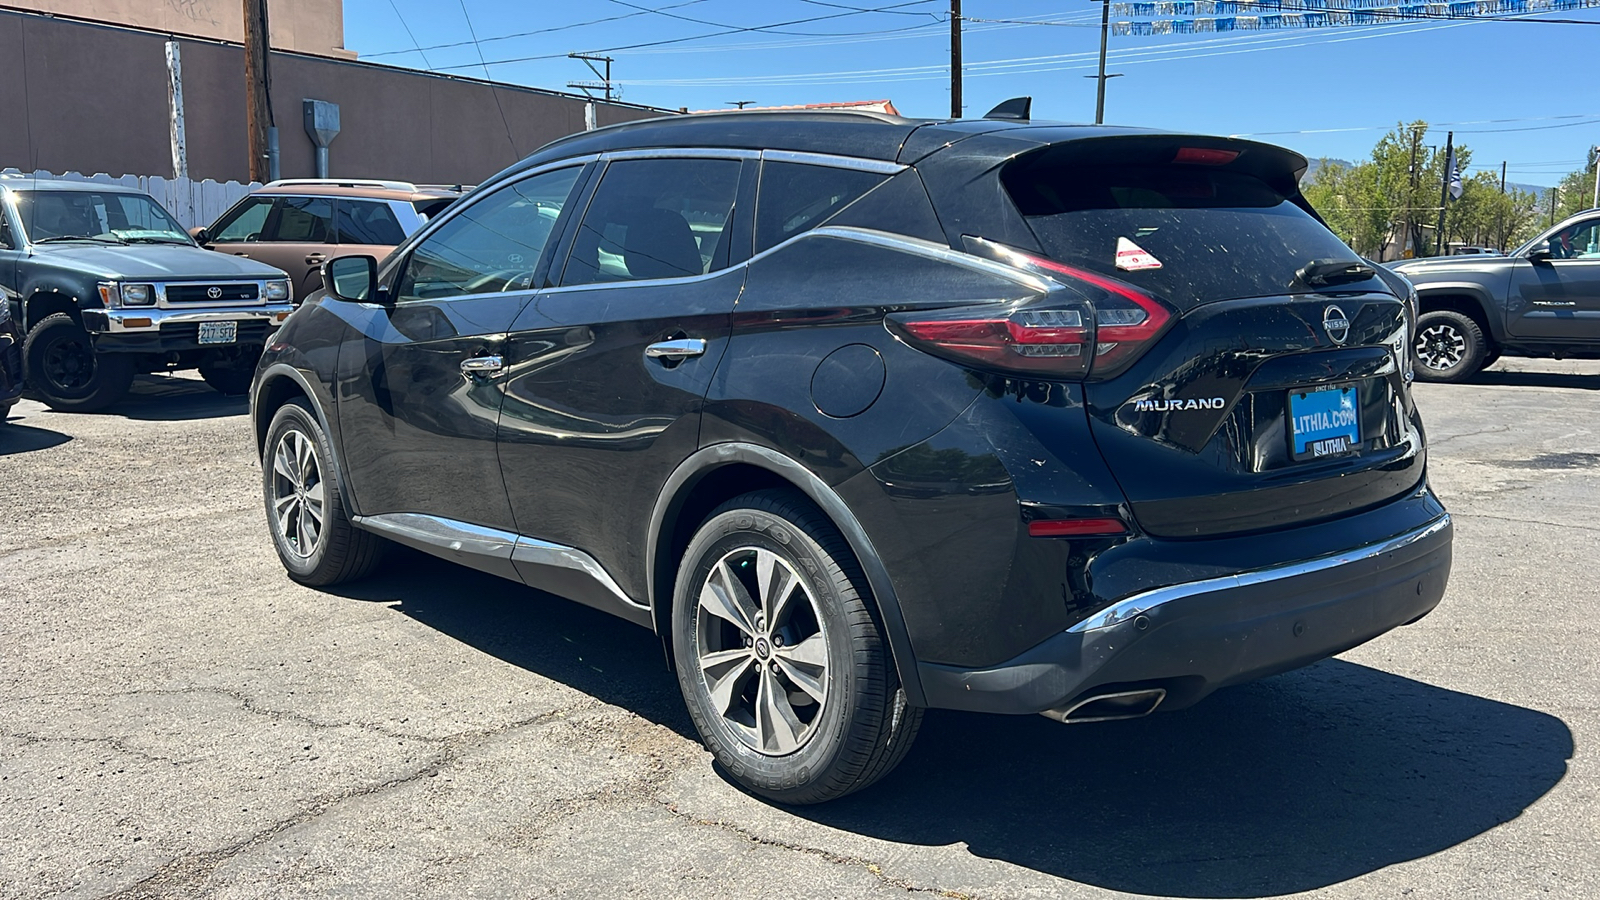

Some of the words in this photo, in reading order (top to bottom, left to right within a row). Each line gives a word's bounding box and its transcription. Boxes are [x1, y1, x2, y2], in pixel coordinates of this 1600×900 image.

[1324, 320, 1349, 330] NISSA
[1134, 397, 1225, 412] MURANO
[1293, 408, 1357, 434] LITHIA.COM
[1320, 438, 1347, 454] LITHIA
[722, 515, 792, 545] TOYO
